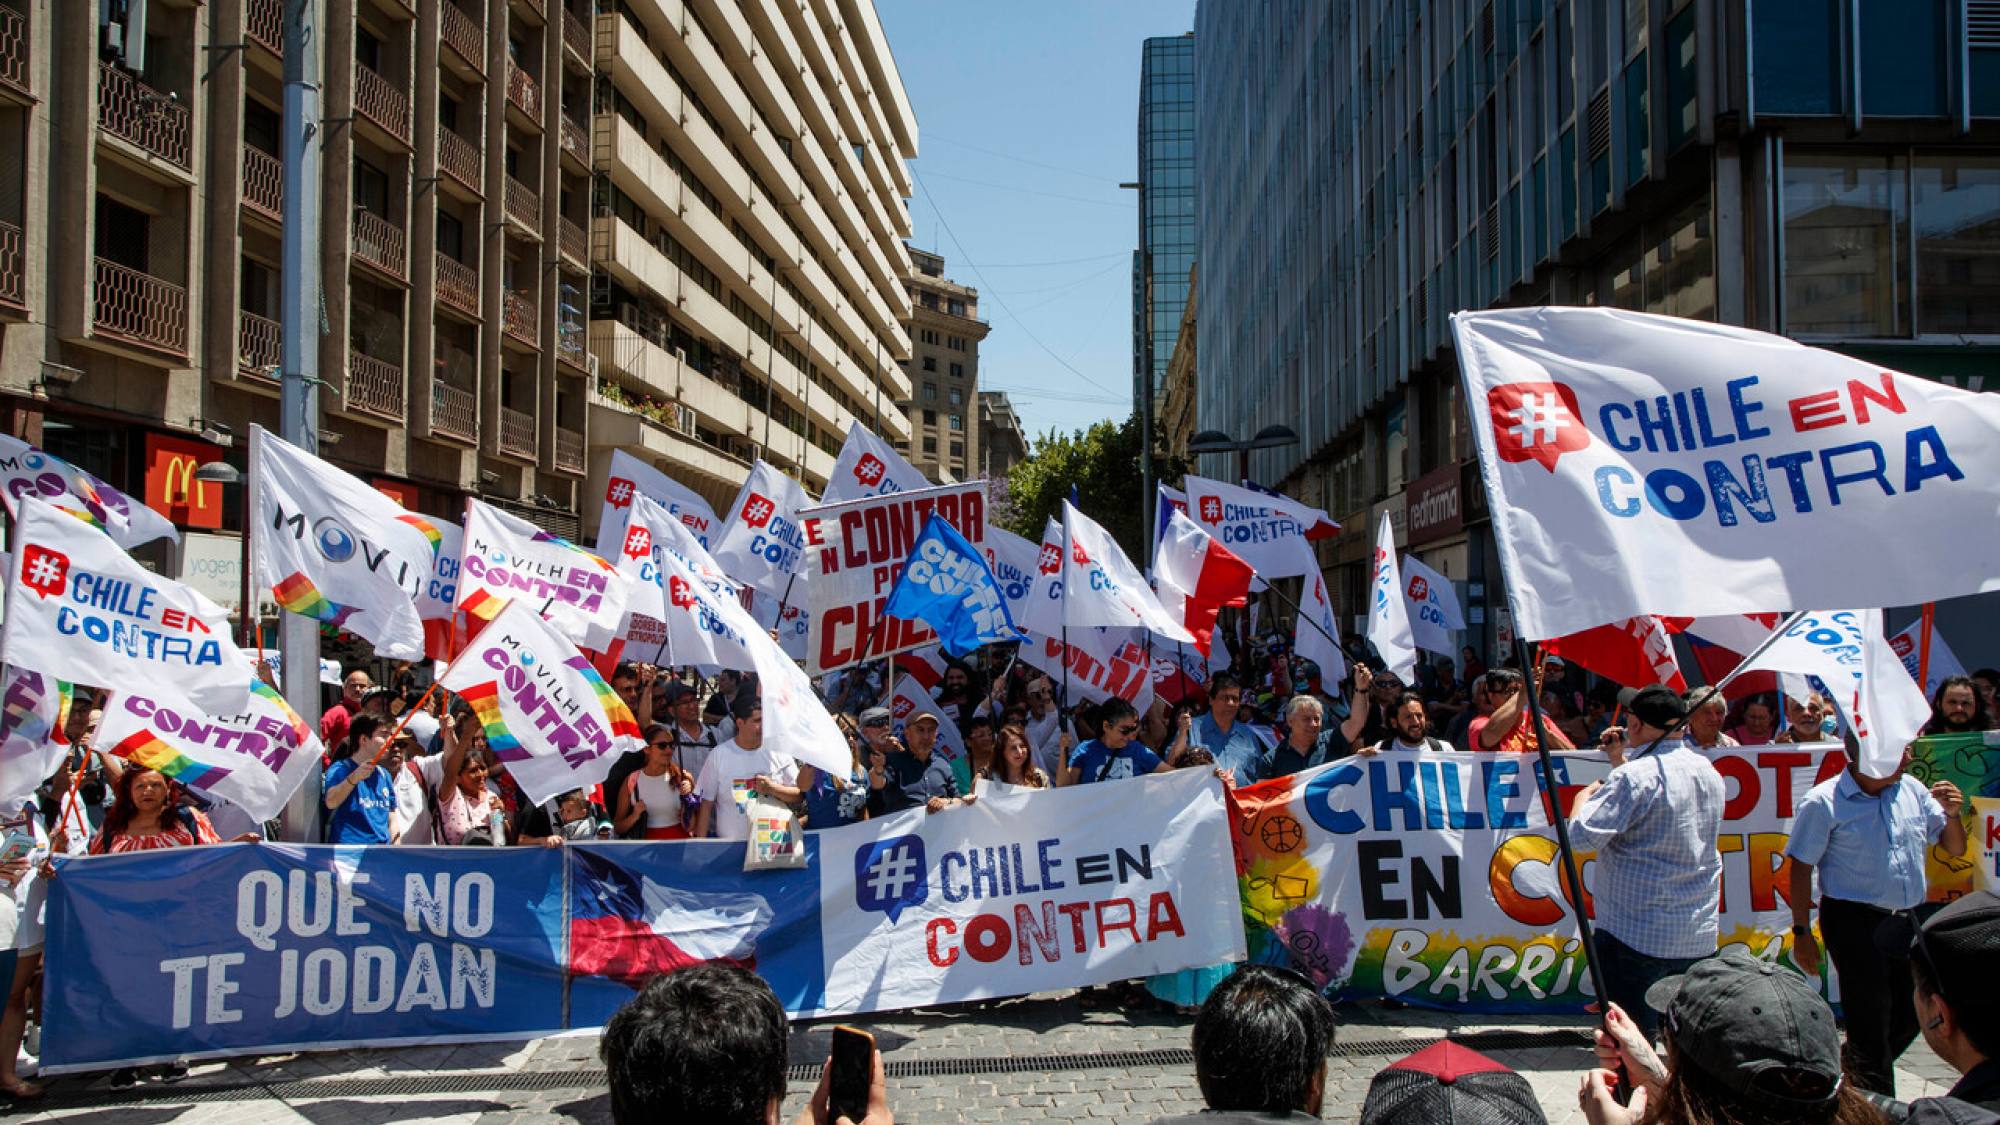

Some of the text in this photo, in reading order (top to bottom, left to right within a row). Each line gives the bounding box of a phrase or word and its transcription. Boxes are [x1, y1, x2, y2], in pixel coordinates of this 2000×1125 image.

[1597, 374, 1770, 453] CHILE
[1788, 371, 1908, 434] EN
[1224, 503, 1269, 522] CHILE
[1410, 486, 1457, 531] redfarma
[1594, 425, 1965, 527] CONTRA
[682, 512, 709, 532] EN
[72, 572, 158, 621] CHILE
[160, 607, 212, 635] EN
[191, 556, 236, 580] yogen
[465, 554, 603, 614] CONTRA
[474, 538, 564, 580] MOVILH
[567, 566, 608, 594] EN
[57, 606, 222, 666] CONTRA
[124, 694, 292, 774] CONTRA
[482, 647, 597, 771] CONTRA
[501, 633, 614, 756] MOVILH EN
[1304, 753, 1528, 835] CHILE
[236, 868, 496, 952] QUE NO
[940, 837, 1066, 905] CHILE
[1075, 843, 1155, 886] EN
[1357, 839, 1463, 921] EN
[925, 890, 1186, 969] CONTRA
[159, 942, 496, 1030] TE JODAN
